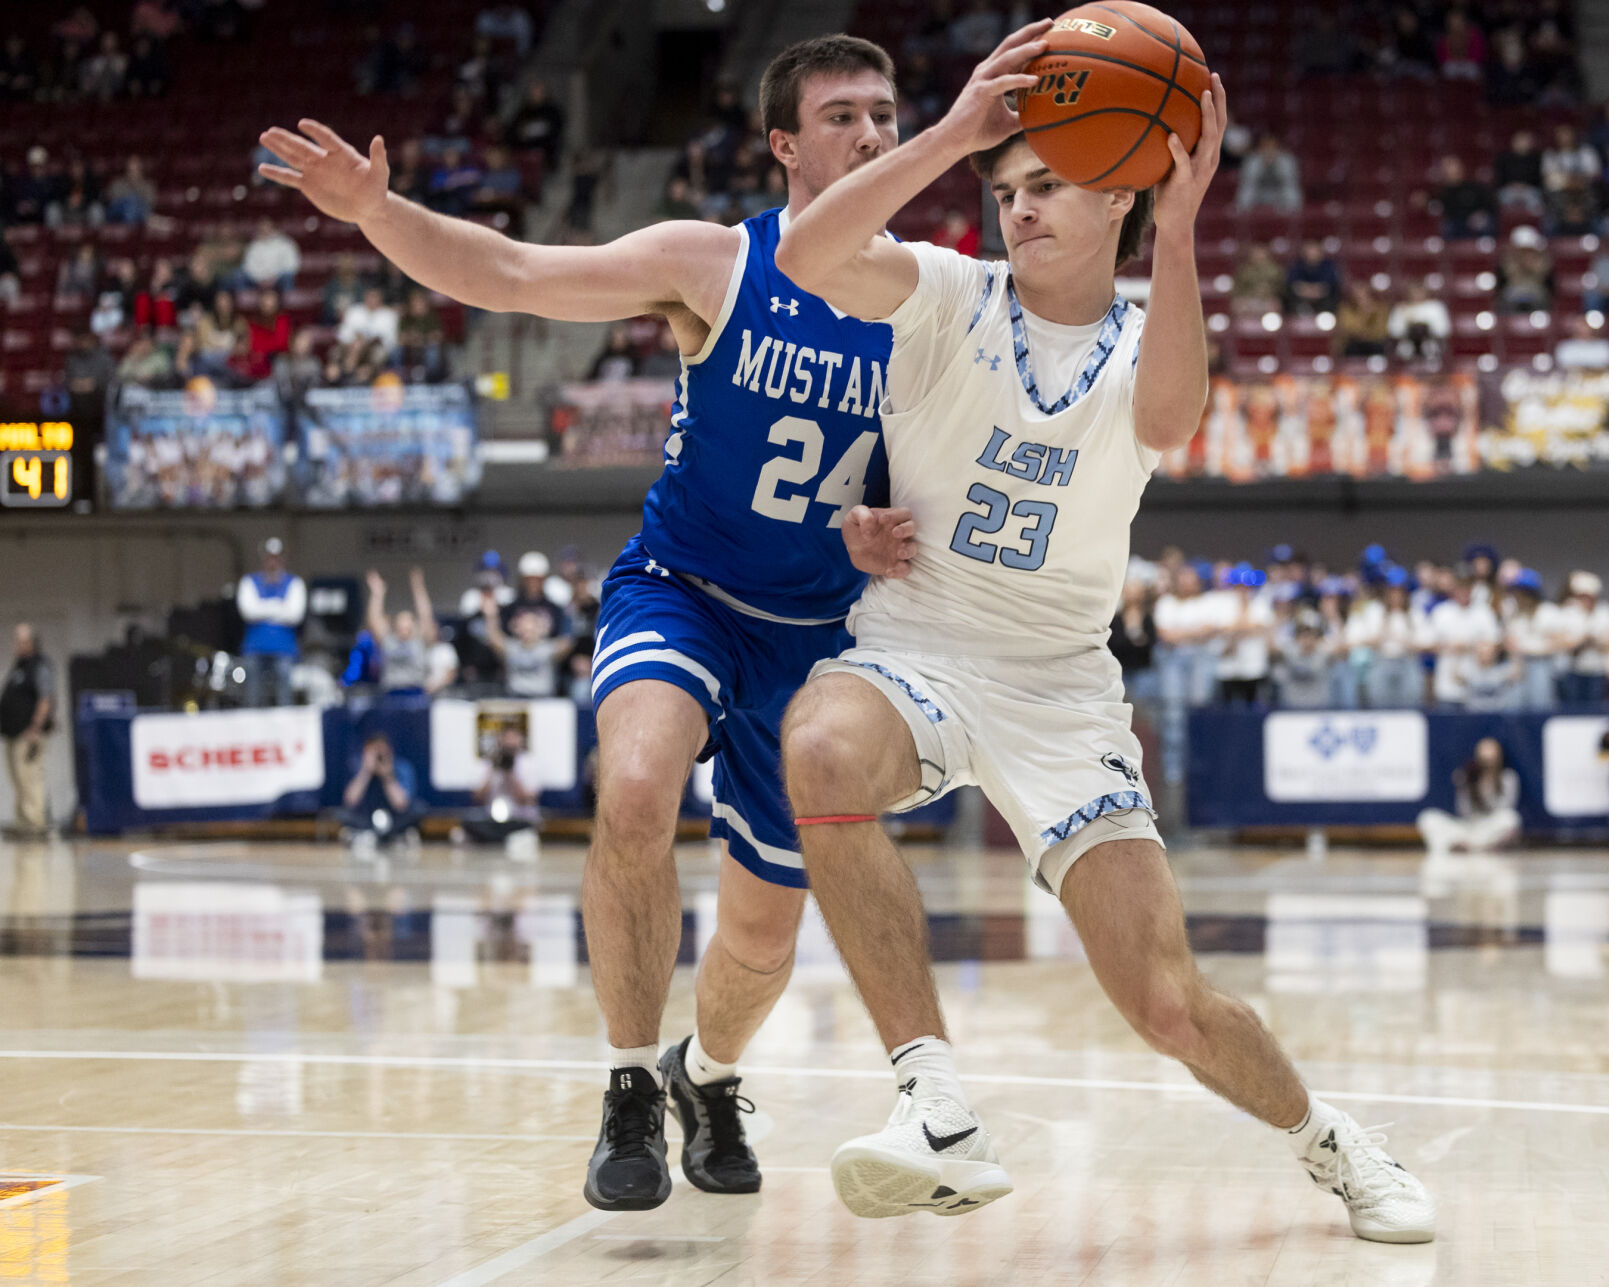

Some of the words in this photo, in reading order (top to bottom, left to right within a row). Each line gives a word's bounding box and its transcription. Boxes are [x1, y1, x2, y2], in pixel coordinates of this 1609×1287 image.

[12, 455, 68, 500] 41
[751, 415, 880, 530] 24
[975, 425, 1079, 487] LSH
[949, 482, 1059, 572] 23
[148, 740, 305, 773] SCHEEL
